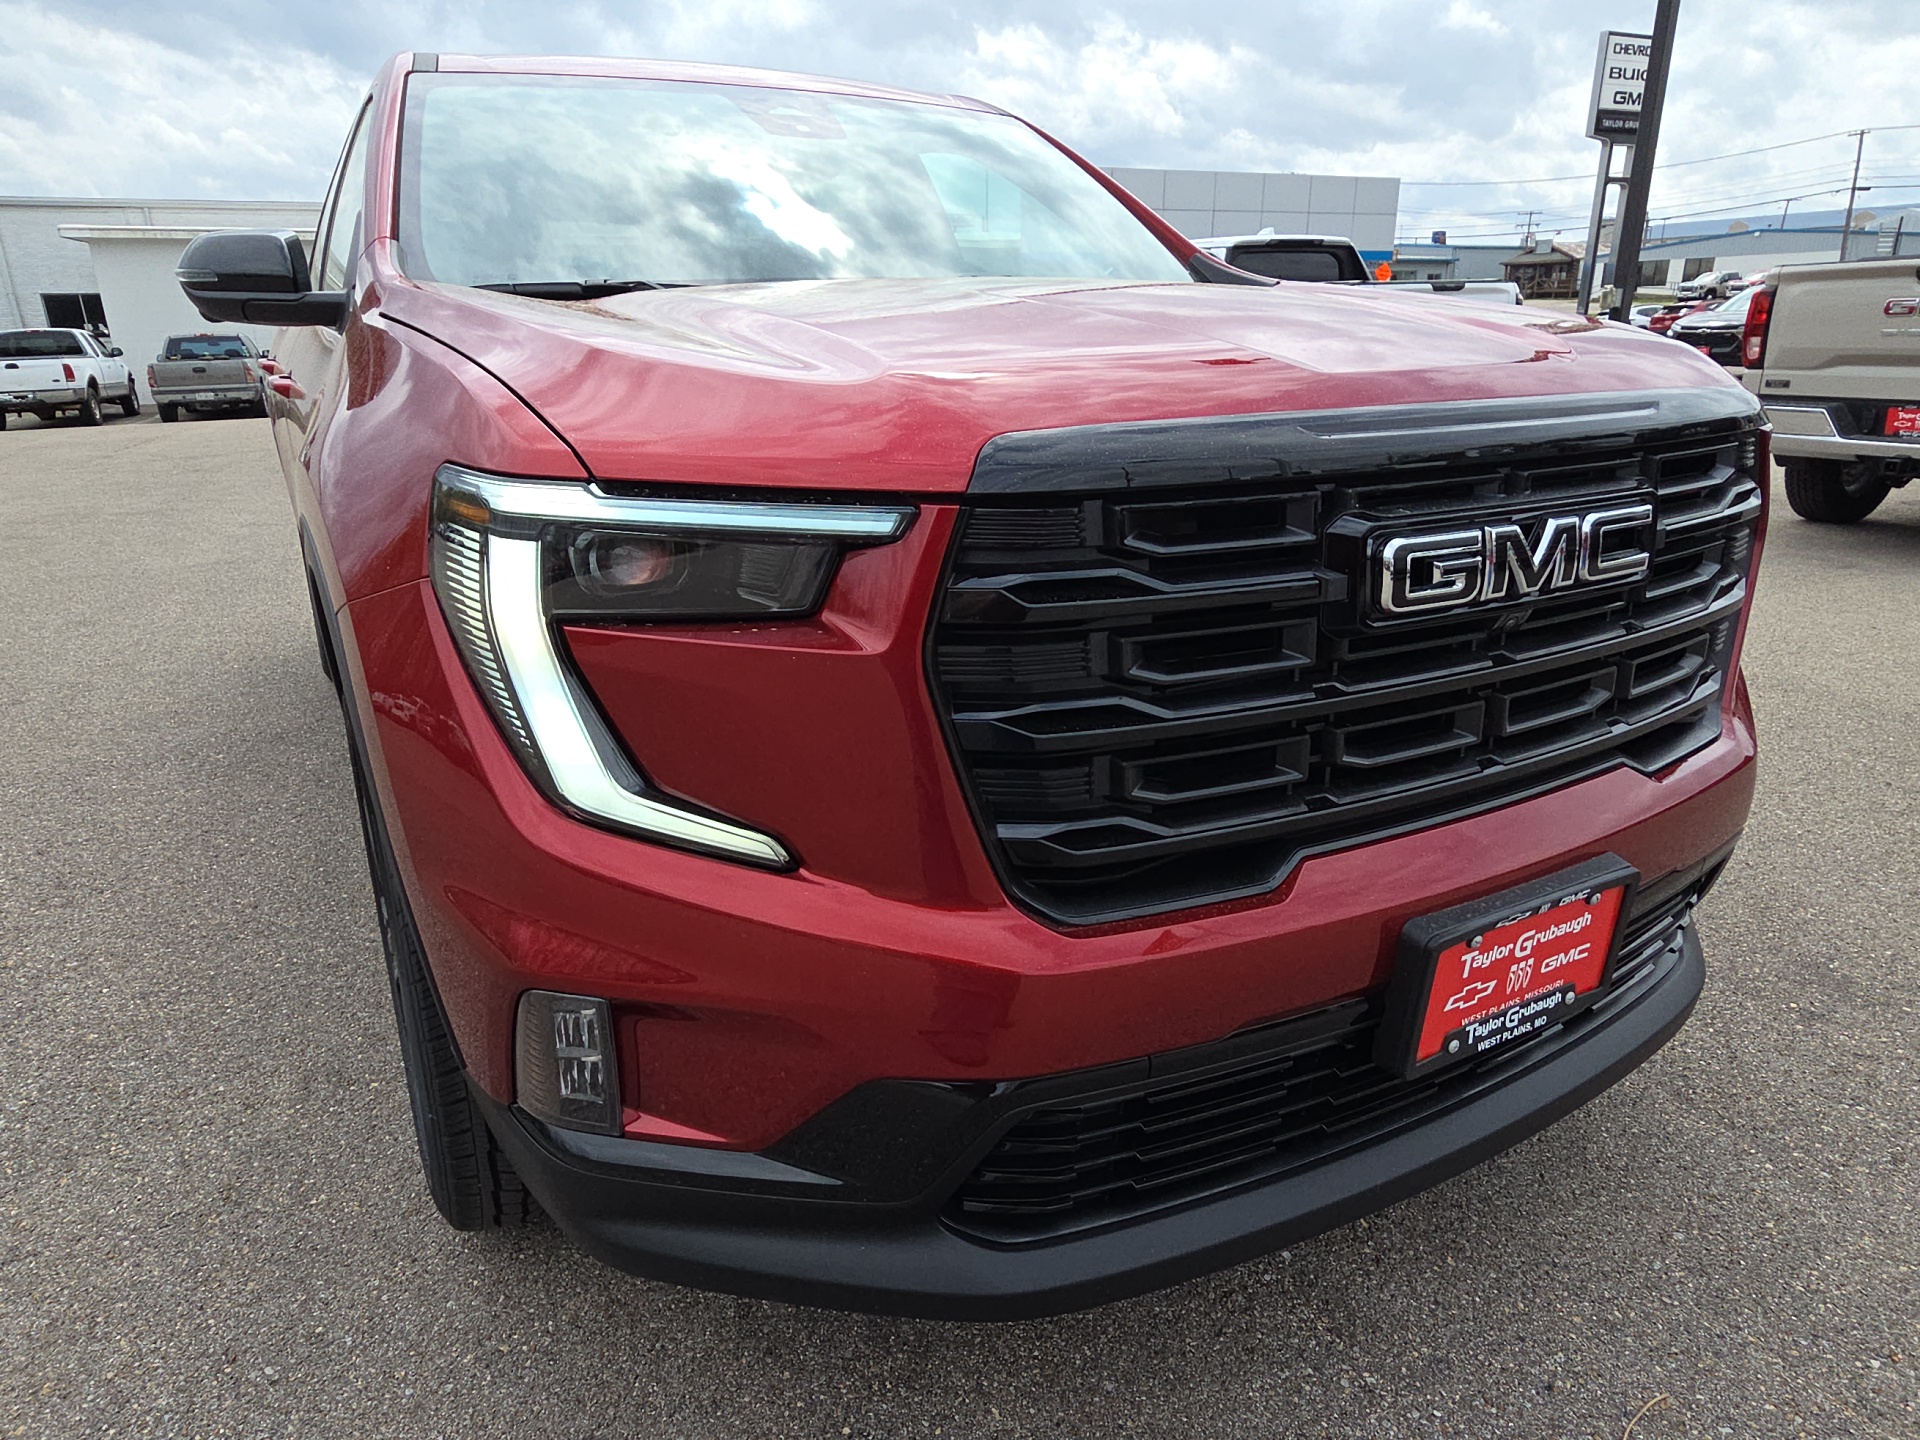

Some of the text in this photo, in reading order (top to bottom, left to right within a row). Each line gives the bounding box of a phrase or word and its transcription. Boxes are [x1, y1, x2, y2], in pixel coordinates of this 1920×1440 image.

[1613, 42, 1651, 57] CHEVRO
[1608, 66, 1648, 81] BUIC
[1612, 90, 1642, 106] GM
[1602, 119, 1640, 129] TAYLOR GRU
[1883, 297, 1920, 317] G
[1380, 504, 1653, 612] GMC
[1461, 911, 1592, 978] Taylor Grubaugh
[1540, 942, 1591, 974] GMC
[1461, 1011, 1487, 1026] WEST
[1524, 979, 1564, 1001] MISSOURI
[1465, 991, 1562, 1045] Taylor Grubaugh
[1477, 1015, 1547, 1052] WEST PLAINS, MO
